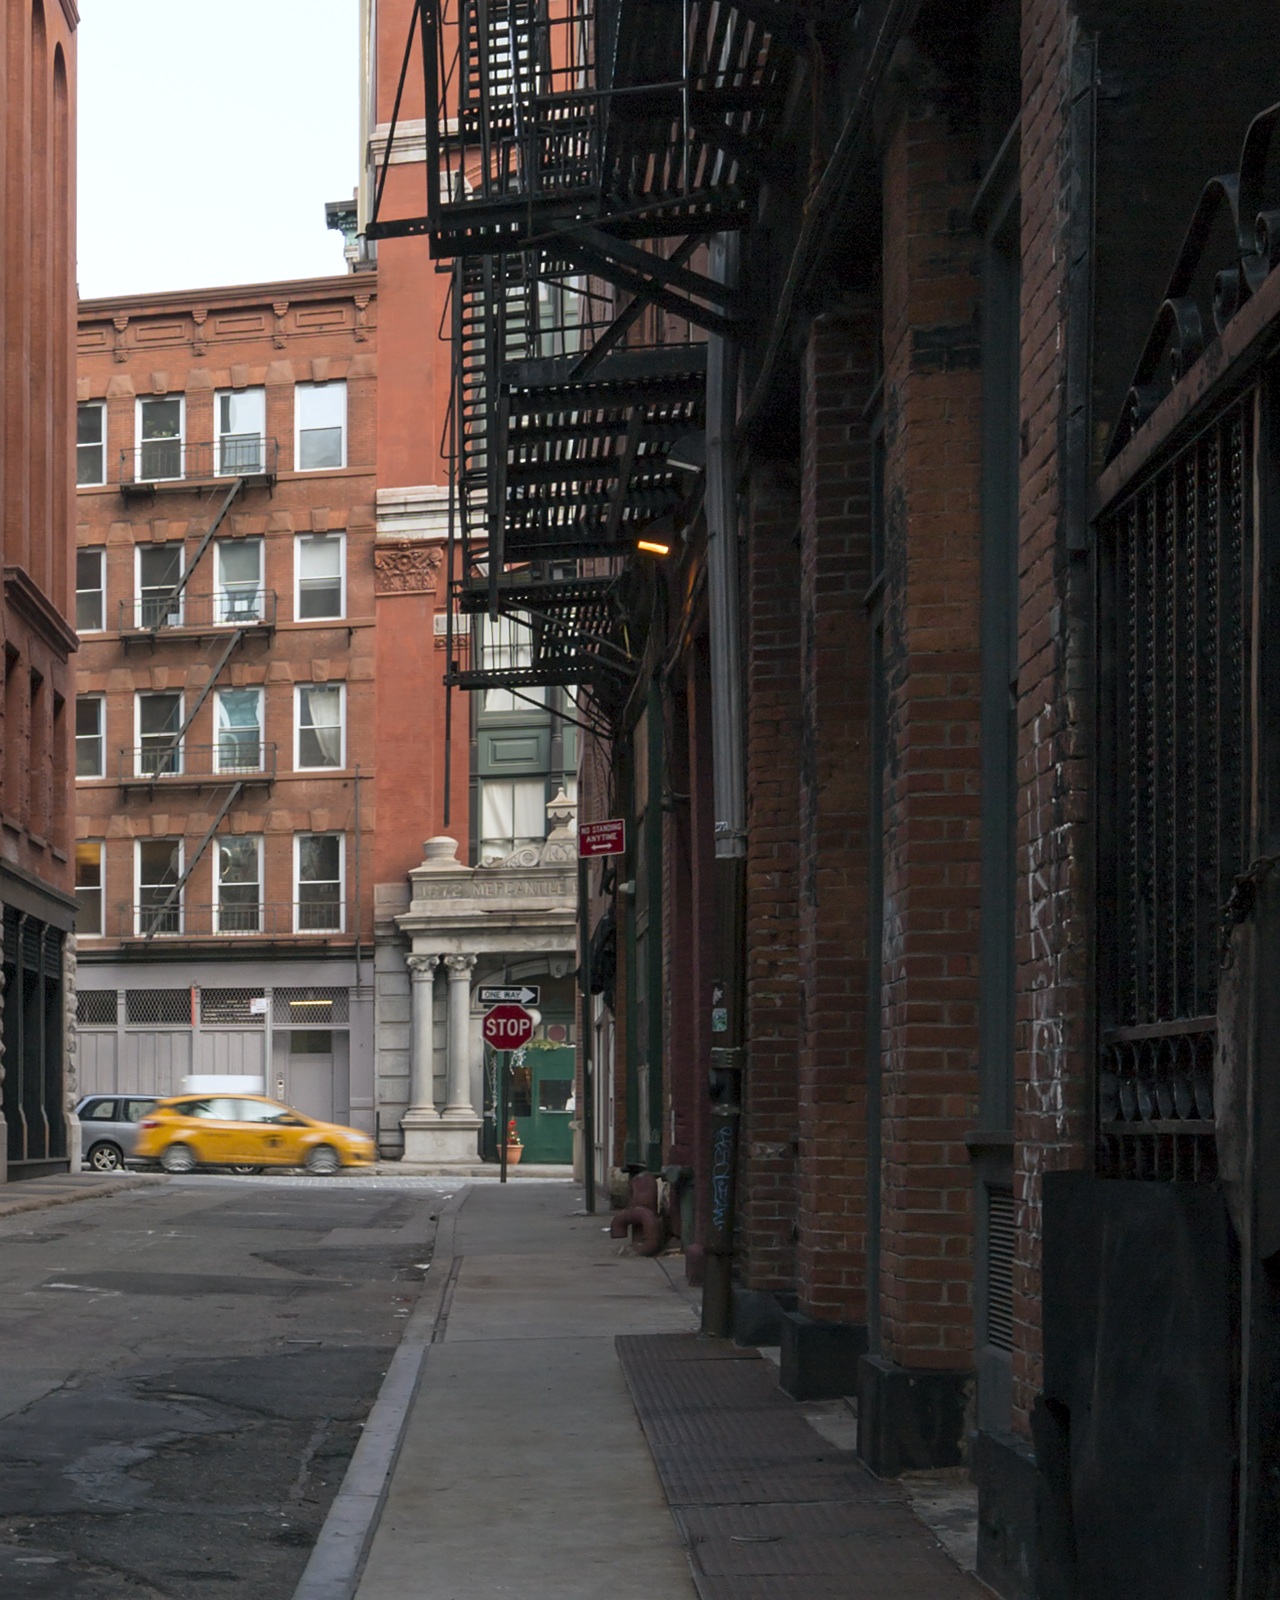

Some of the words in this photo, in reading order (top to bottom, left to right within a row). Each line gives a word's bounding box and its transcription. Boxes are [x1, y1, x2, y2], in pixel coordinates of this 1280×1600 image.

[581, 827, 590, 835] NO
[592, 823, 621, 833] STANDING
[586, 832, 618, 843] ANYTIME
[473, 881, 565, 896] MERCANTILE
[484, 991, 501, 999] ONE
[503, 991, 521, 999] WAY
[486, 1018, 530, 1037] STOP
